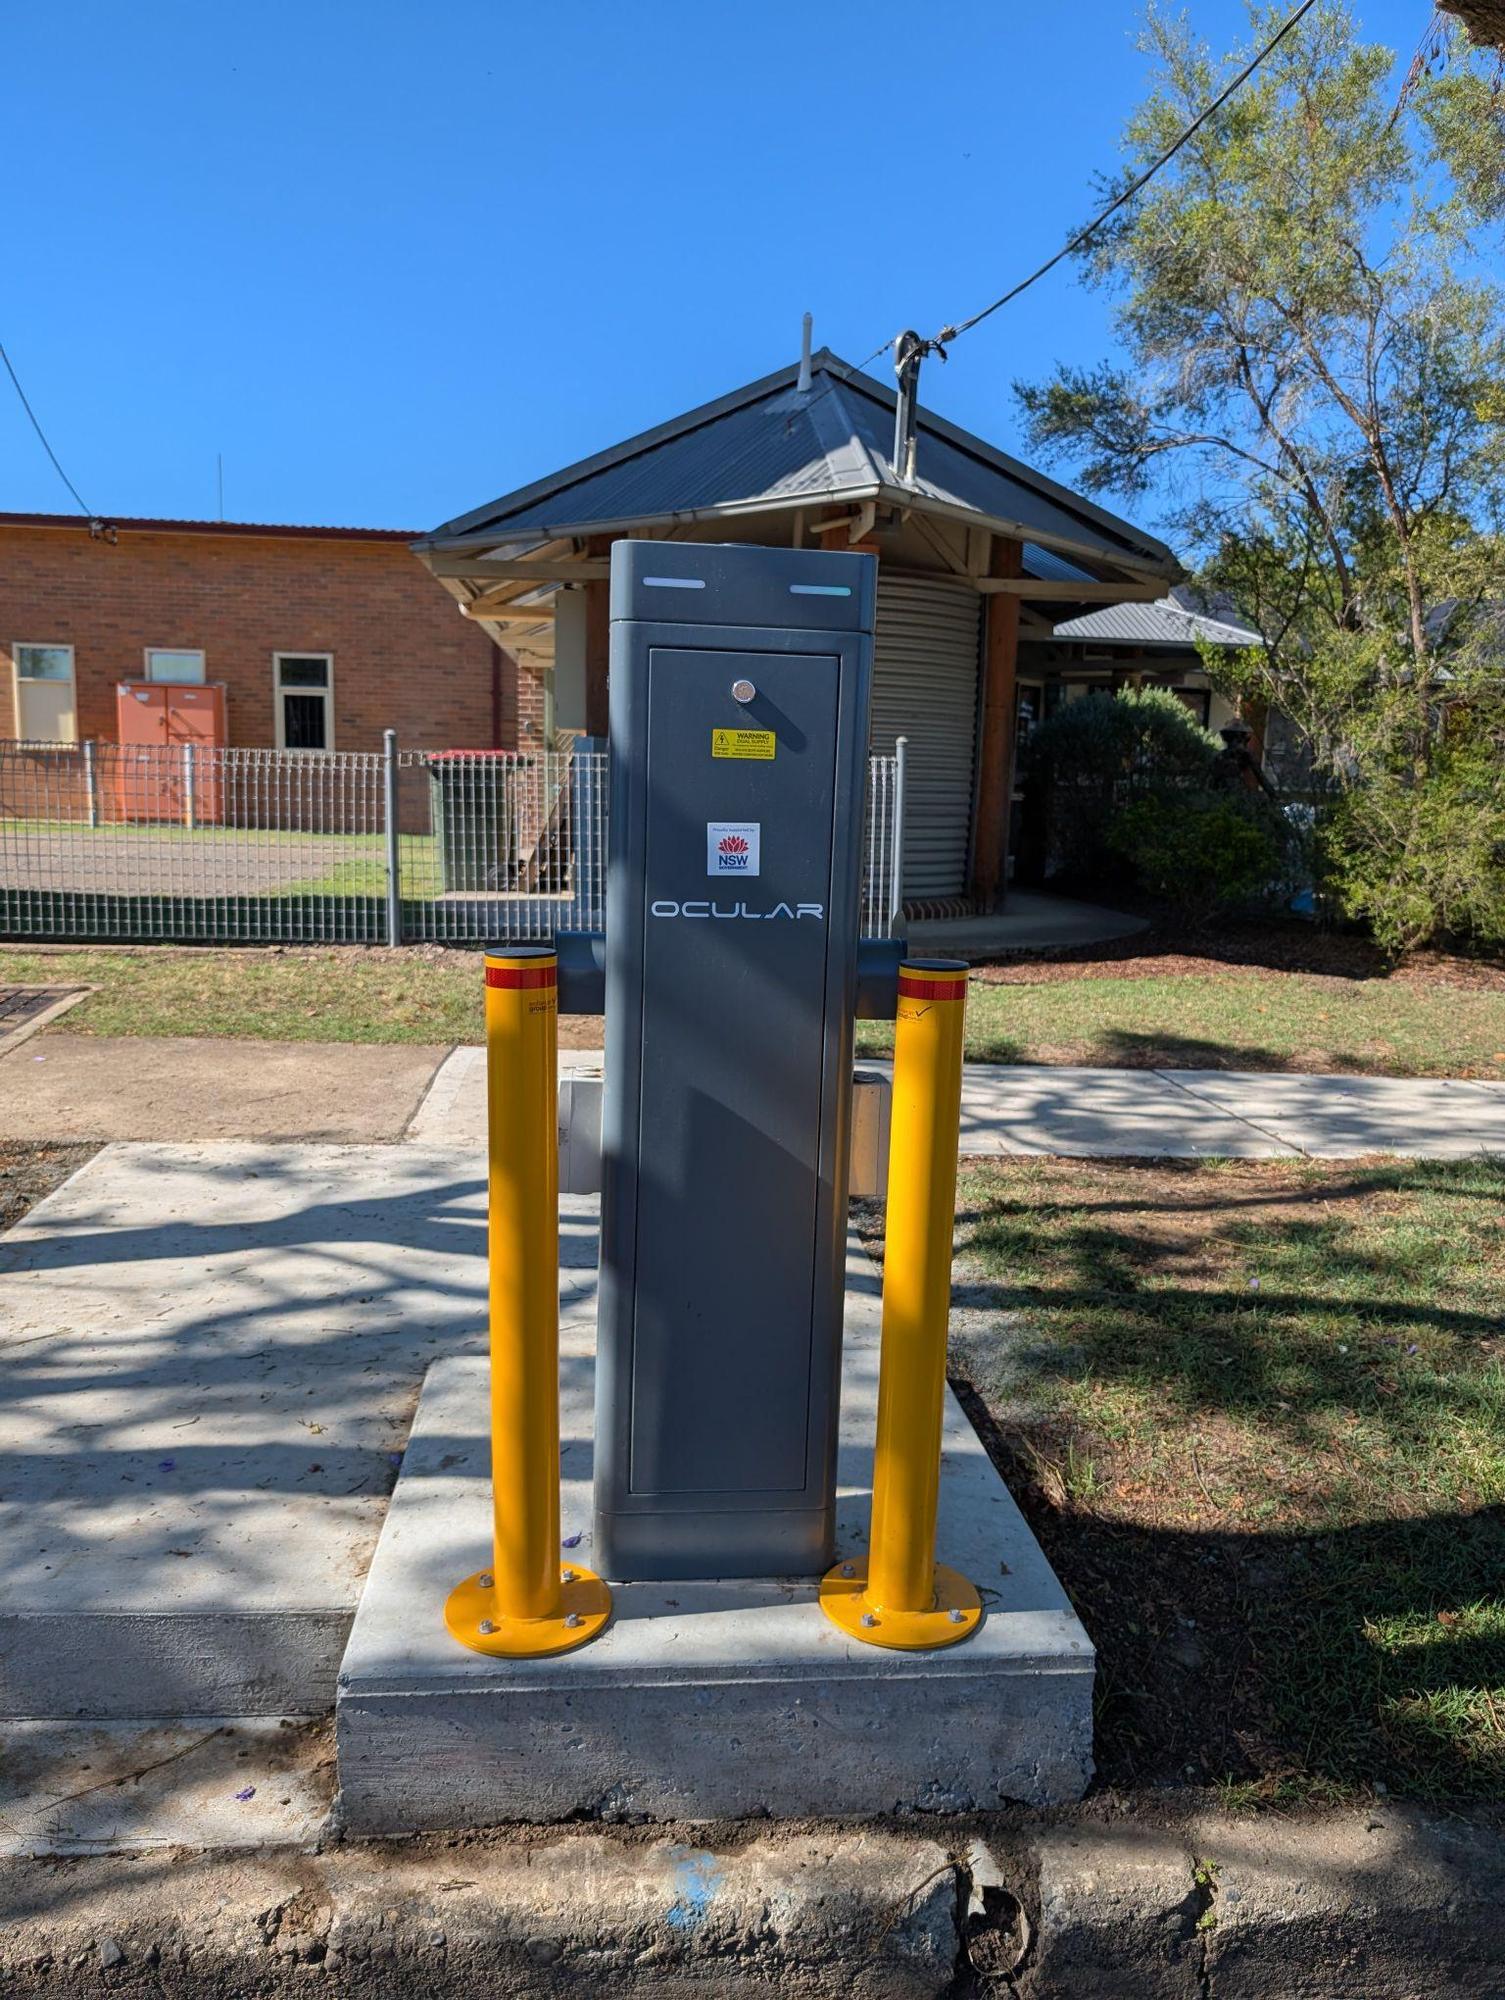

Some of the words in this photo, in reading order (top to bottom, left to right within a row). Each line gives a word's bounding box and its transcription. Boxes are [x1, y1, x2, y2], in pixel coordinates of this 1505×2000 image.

[736, 732, 770, 740] WARNING
[719, 855, 749, 865] NSW
[651, 900, 824, 920] OCULAR
